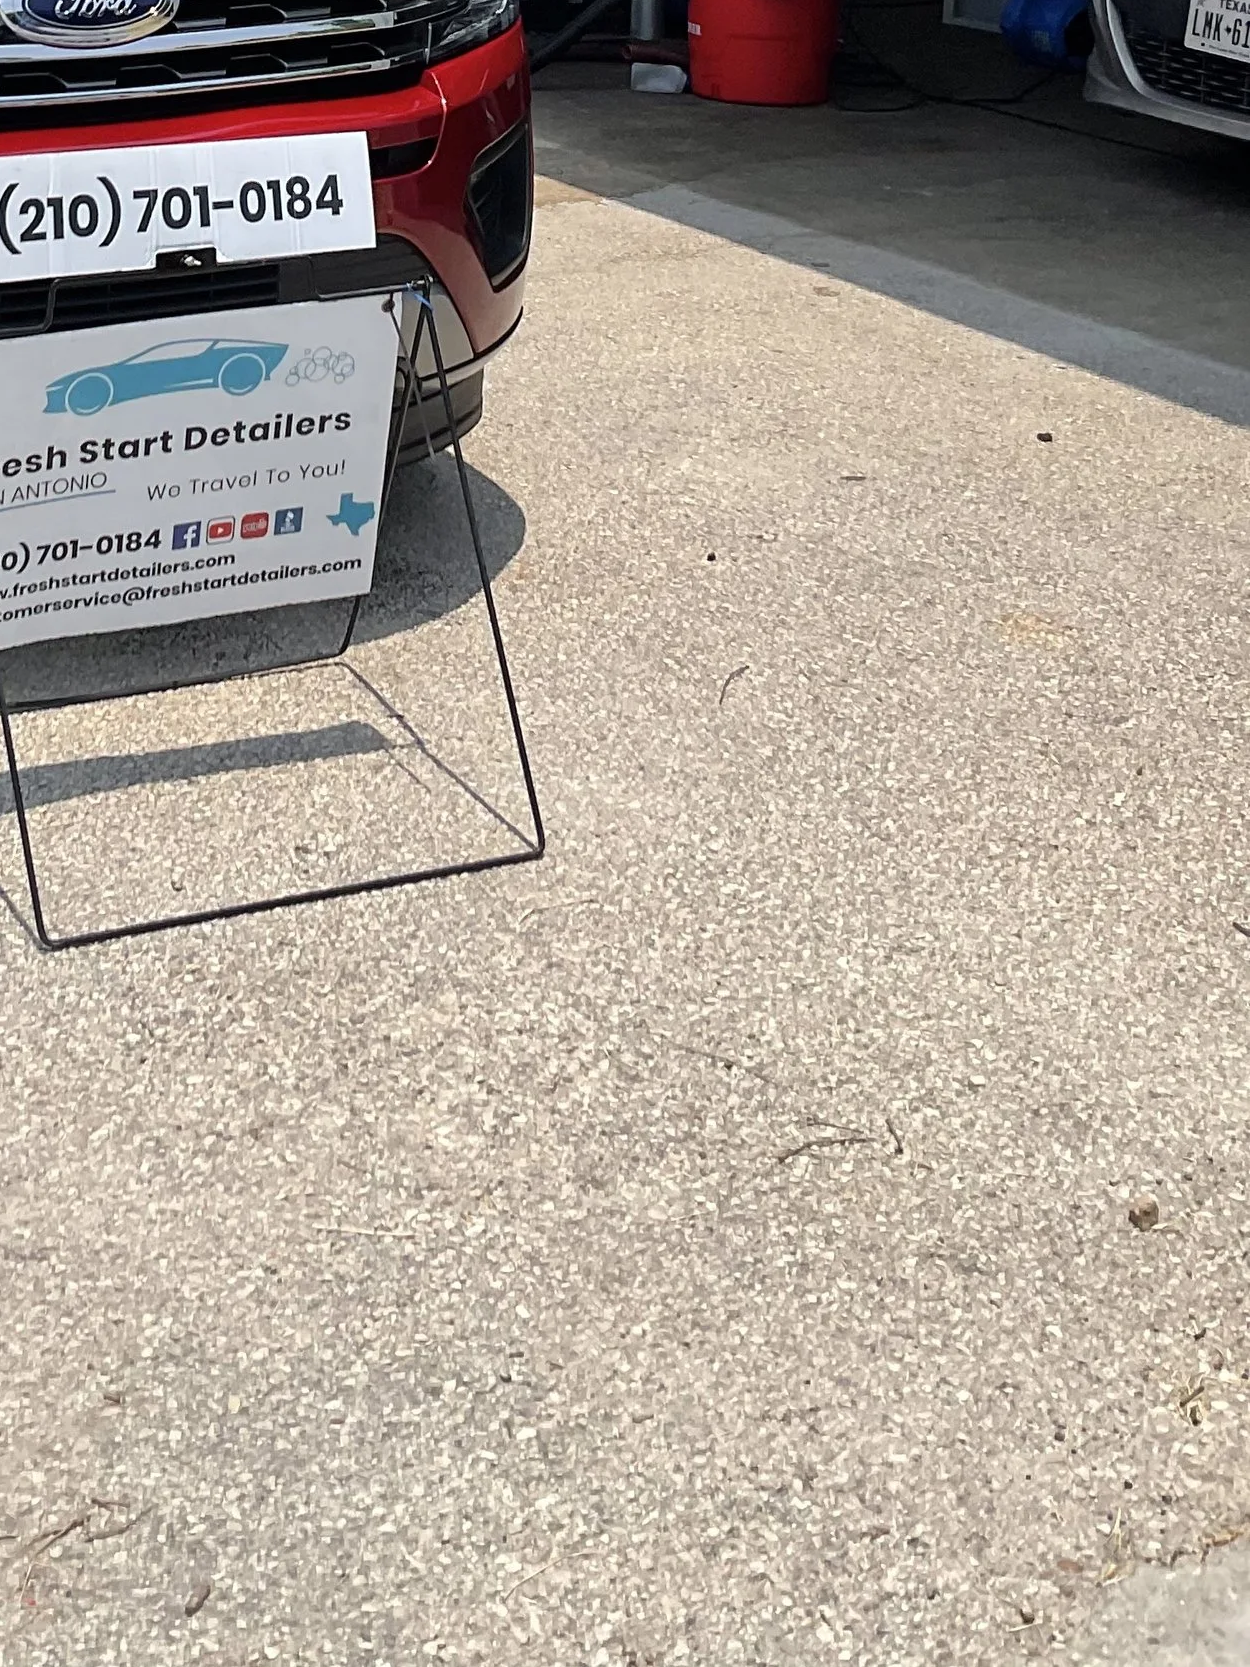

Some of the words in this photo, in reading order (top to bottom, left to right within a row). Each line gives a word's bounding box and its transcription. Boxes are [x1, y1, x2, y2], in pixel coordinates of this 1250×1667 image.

[133, 174, 344, 233] 701-0184
[79, 430, 173, 464] Start
[184, 412, 352, 451] Detailers
[11, 472, 108, 504] ANTONIO
[147, 484, 181, 501] We
[189, 470, 258, 495] Travel
[266, 468, 291, 485] To
[299, 459, 346, 481] You!
[36, 528, 163, 566] 701-0184
